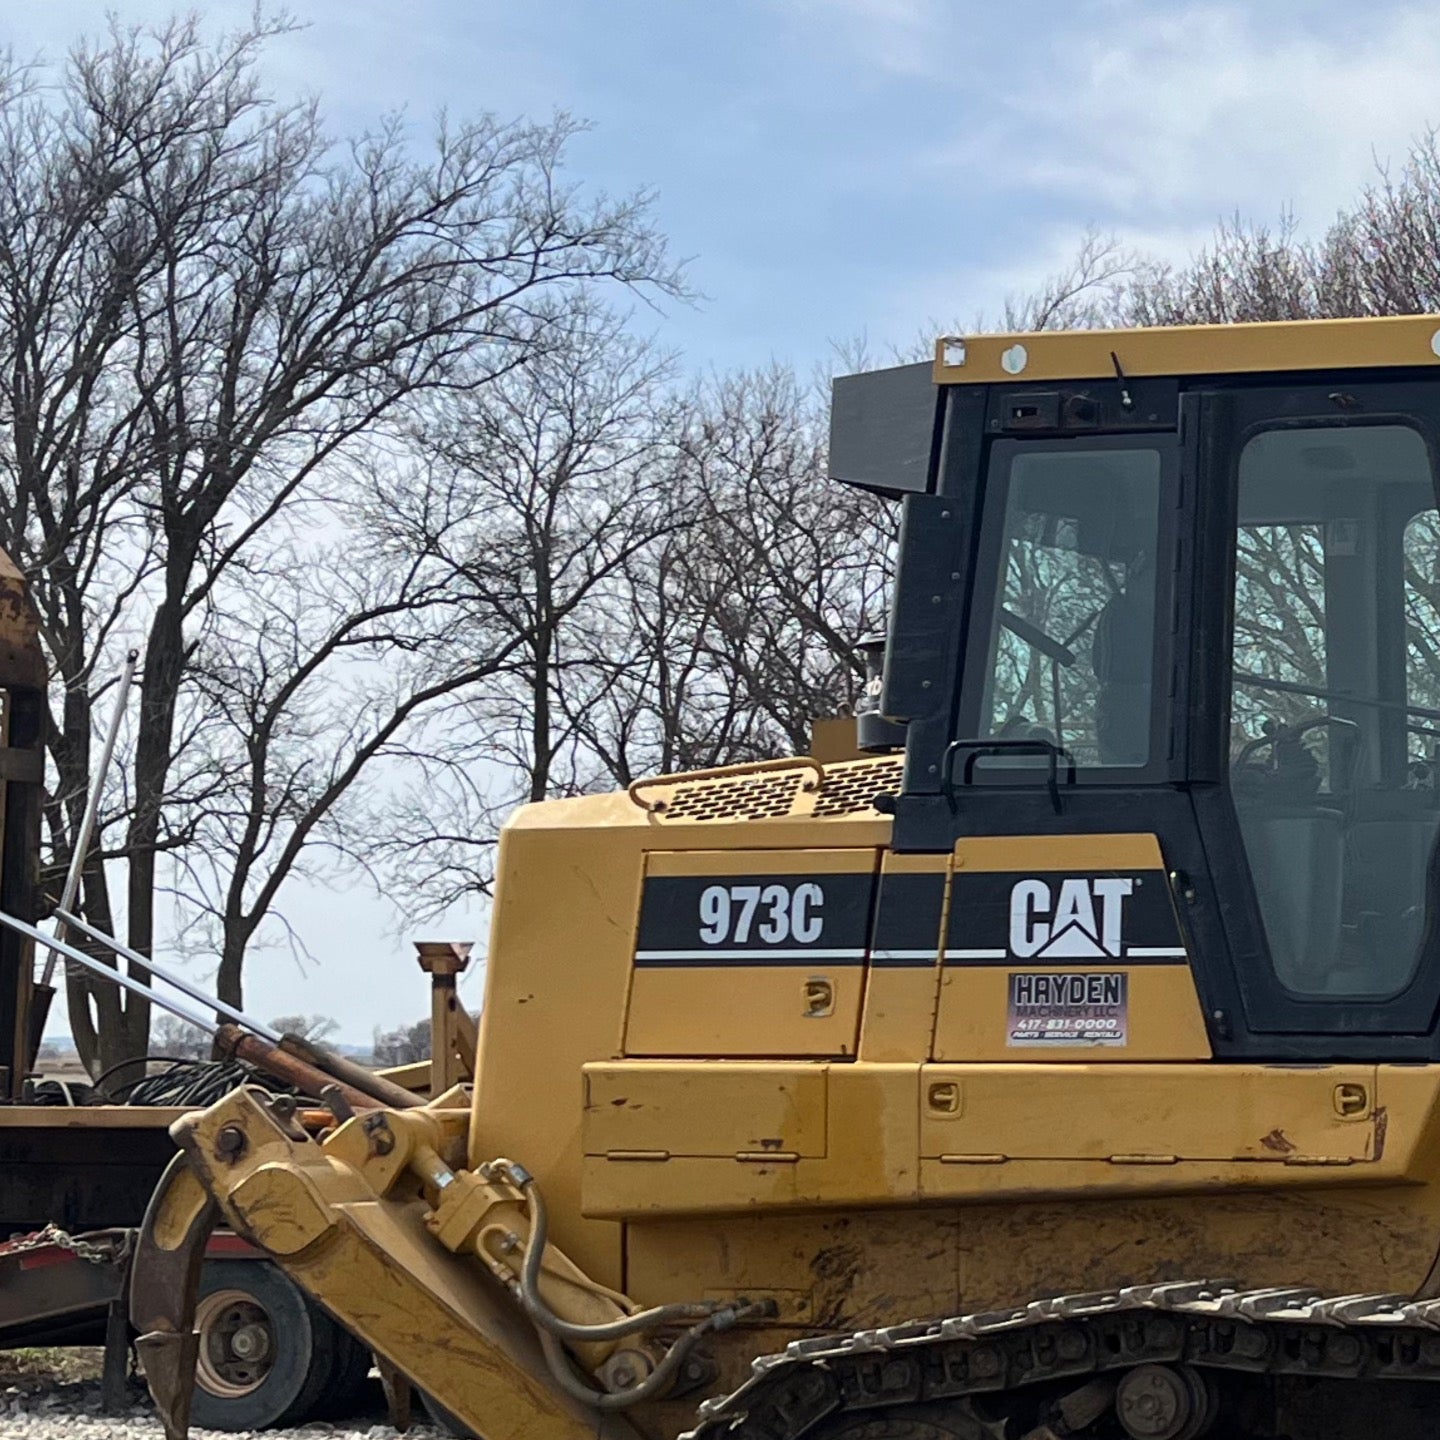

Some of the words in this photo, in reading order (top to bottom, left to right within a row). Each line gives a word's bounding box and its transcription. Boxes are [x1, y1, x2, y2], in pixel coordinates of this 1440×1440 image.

[699, 882, 824, 944] 973C
[1009, 878, 1133, 958] CAT
[1015, 974, 1121, 1006] HAYDEN
[1016, 1006, 1091, 1017] MACHINERY
[1017, 1019, 1117, 1029] 417-831-0000
